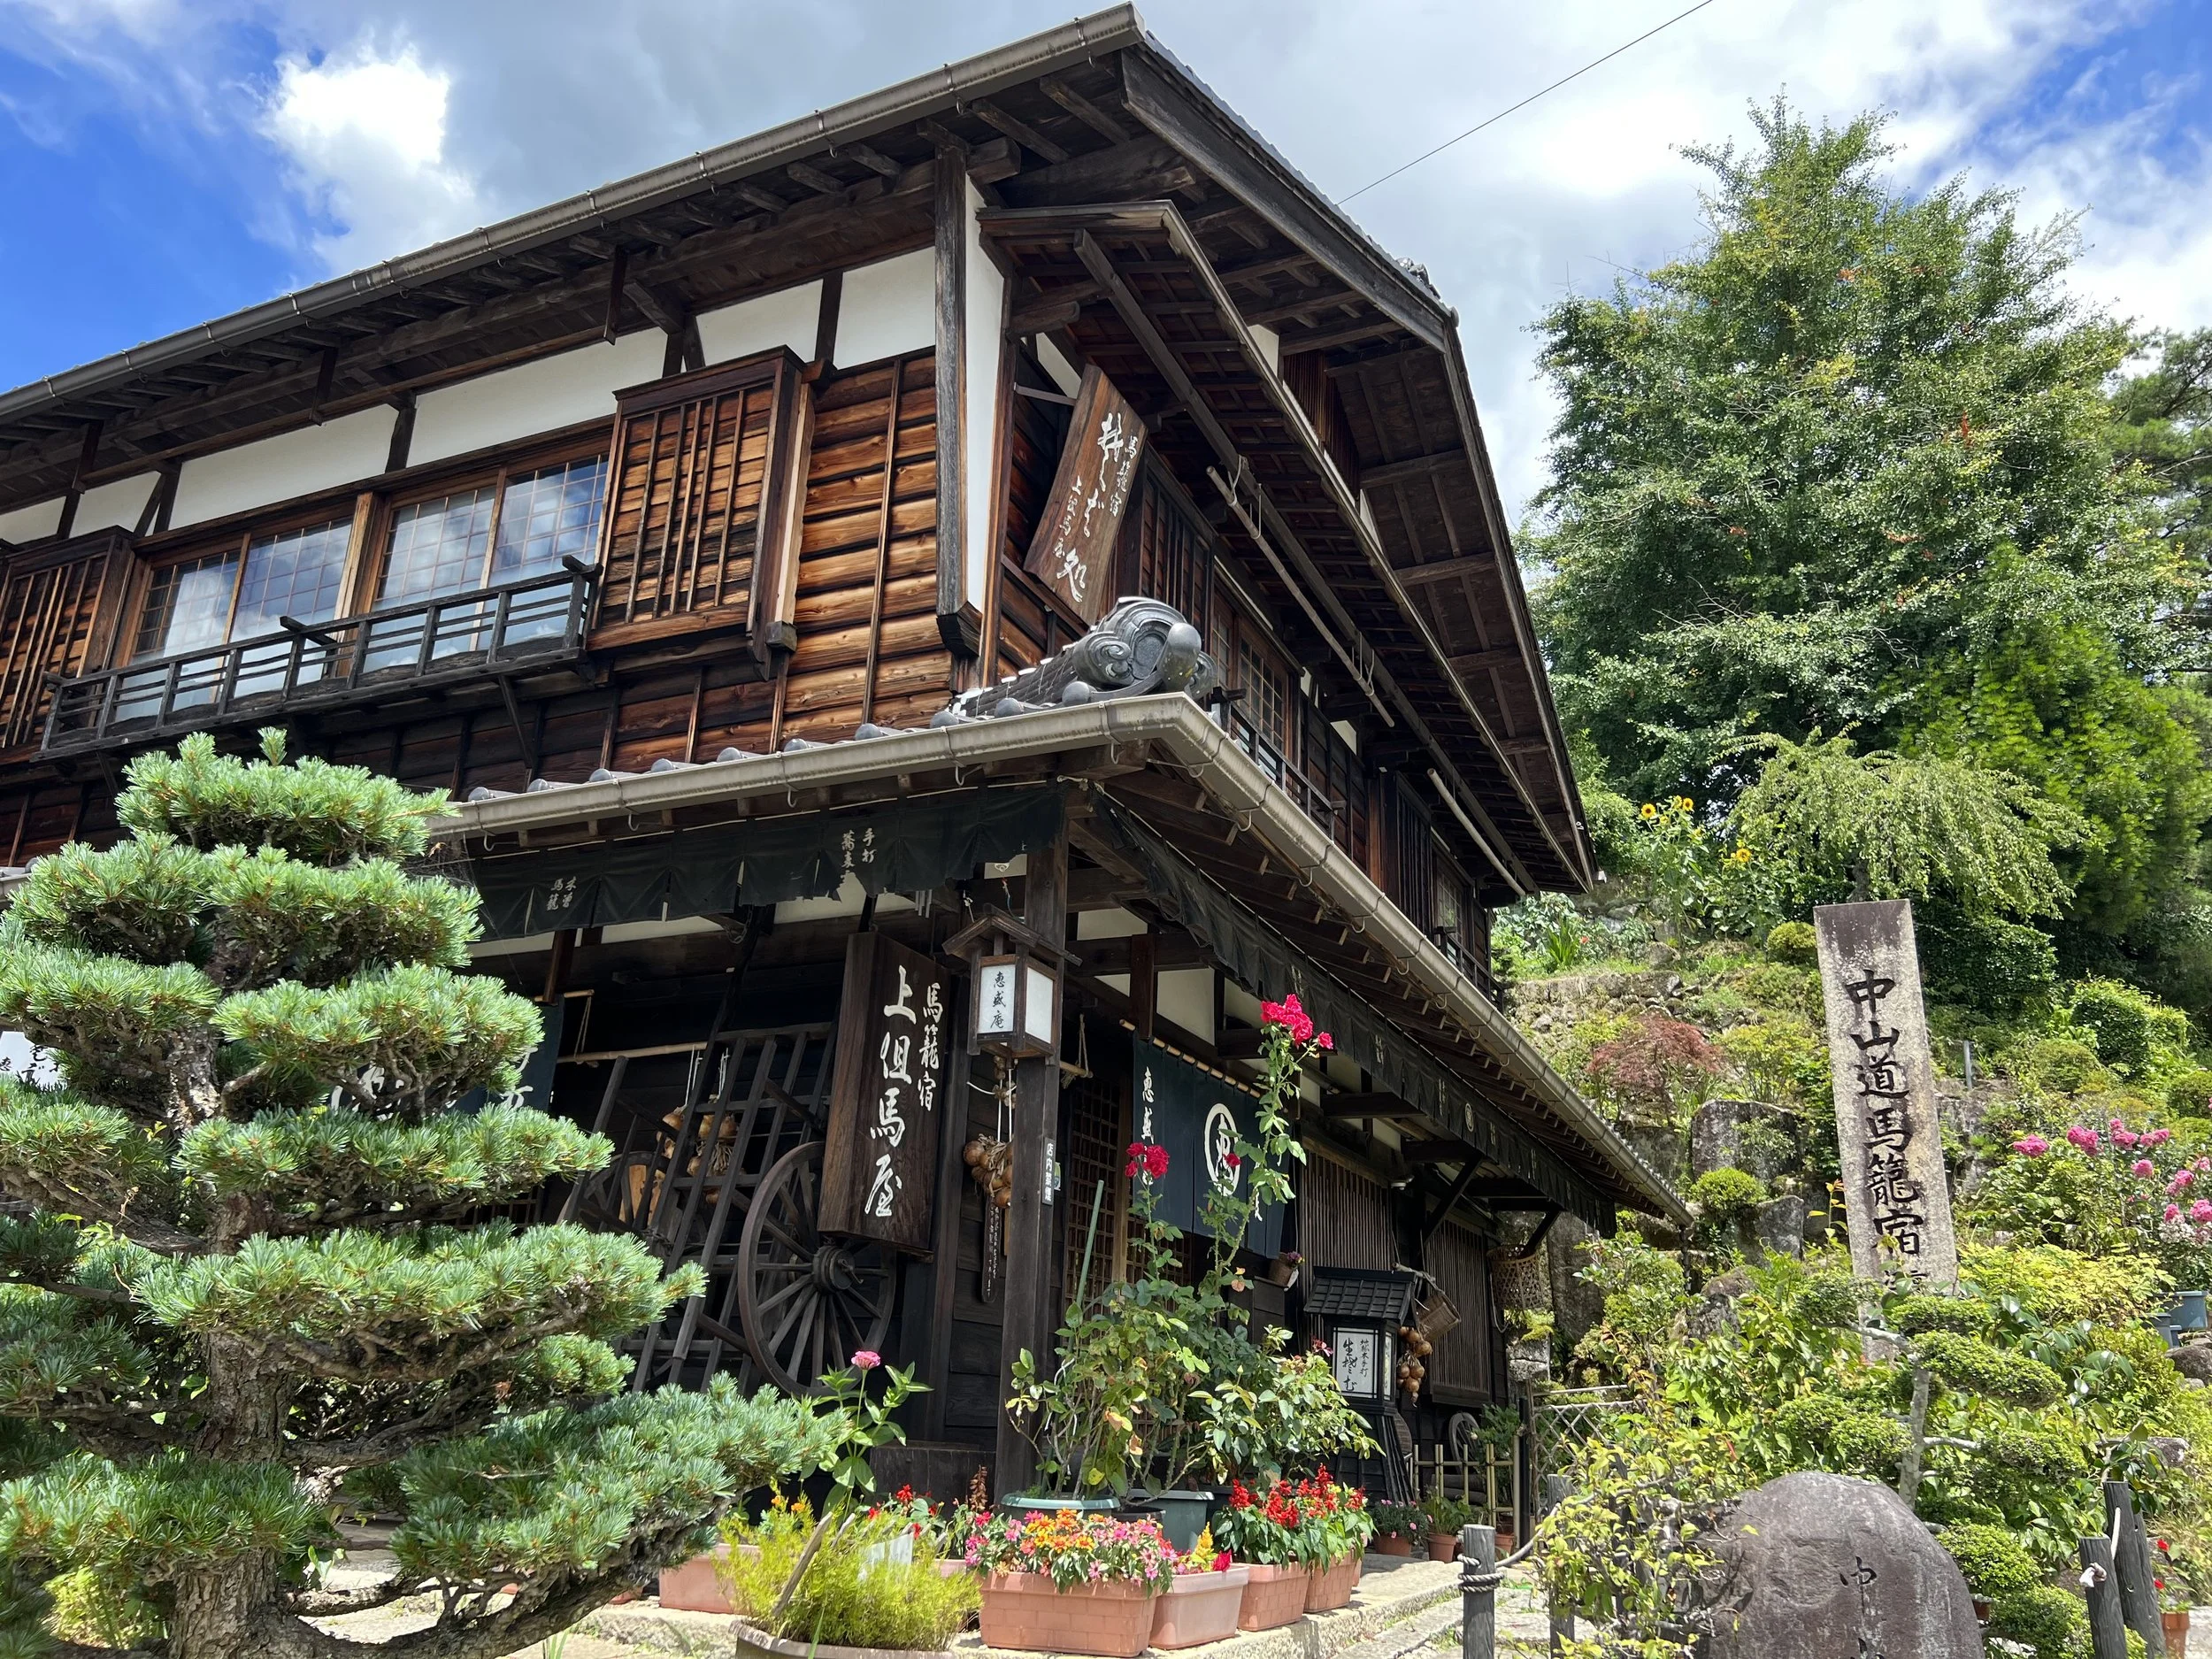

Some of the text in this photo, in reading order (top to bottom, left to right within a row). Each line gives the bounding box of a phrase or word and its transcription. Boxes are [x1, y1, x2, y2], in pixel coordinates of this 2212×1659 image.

[861, 827, 878, 864] 手打
[917, 982, 943, 1112] 馬籠宿
[1141, 1065, 1155, 1186] 恵盛
[1846, 969, 1924, 1255] 中山道馬籠宿
